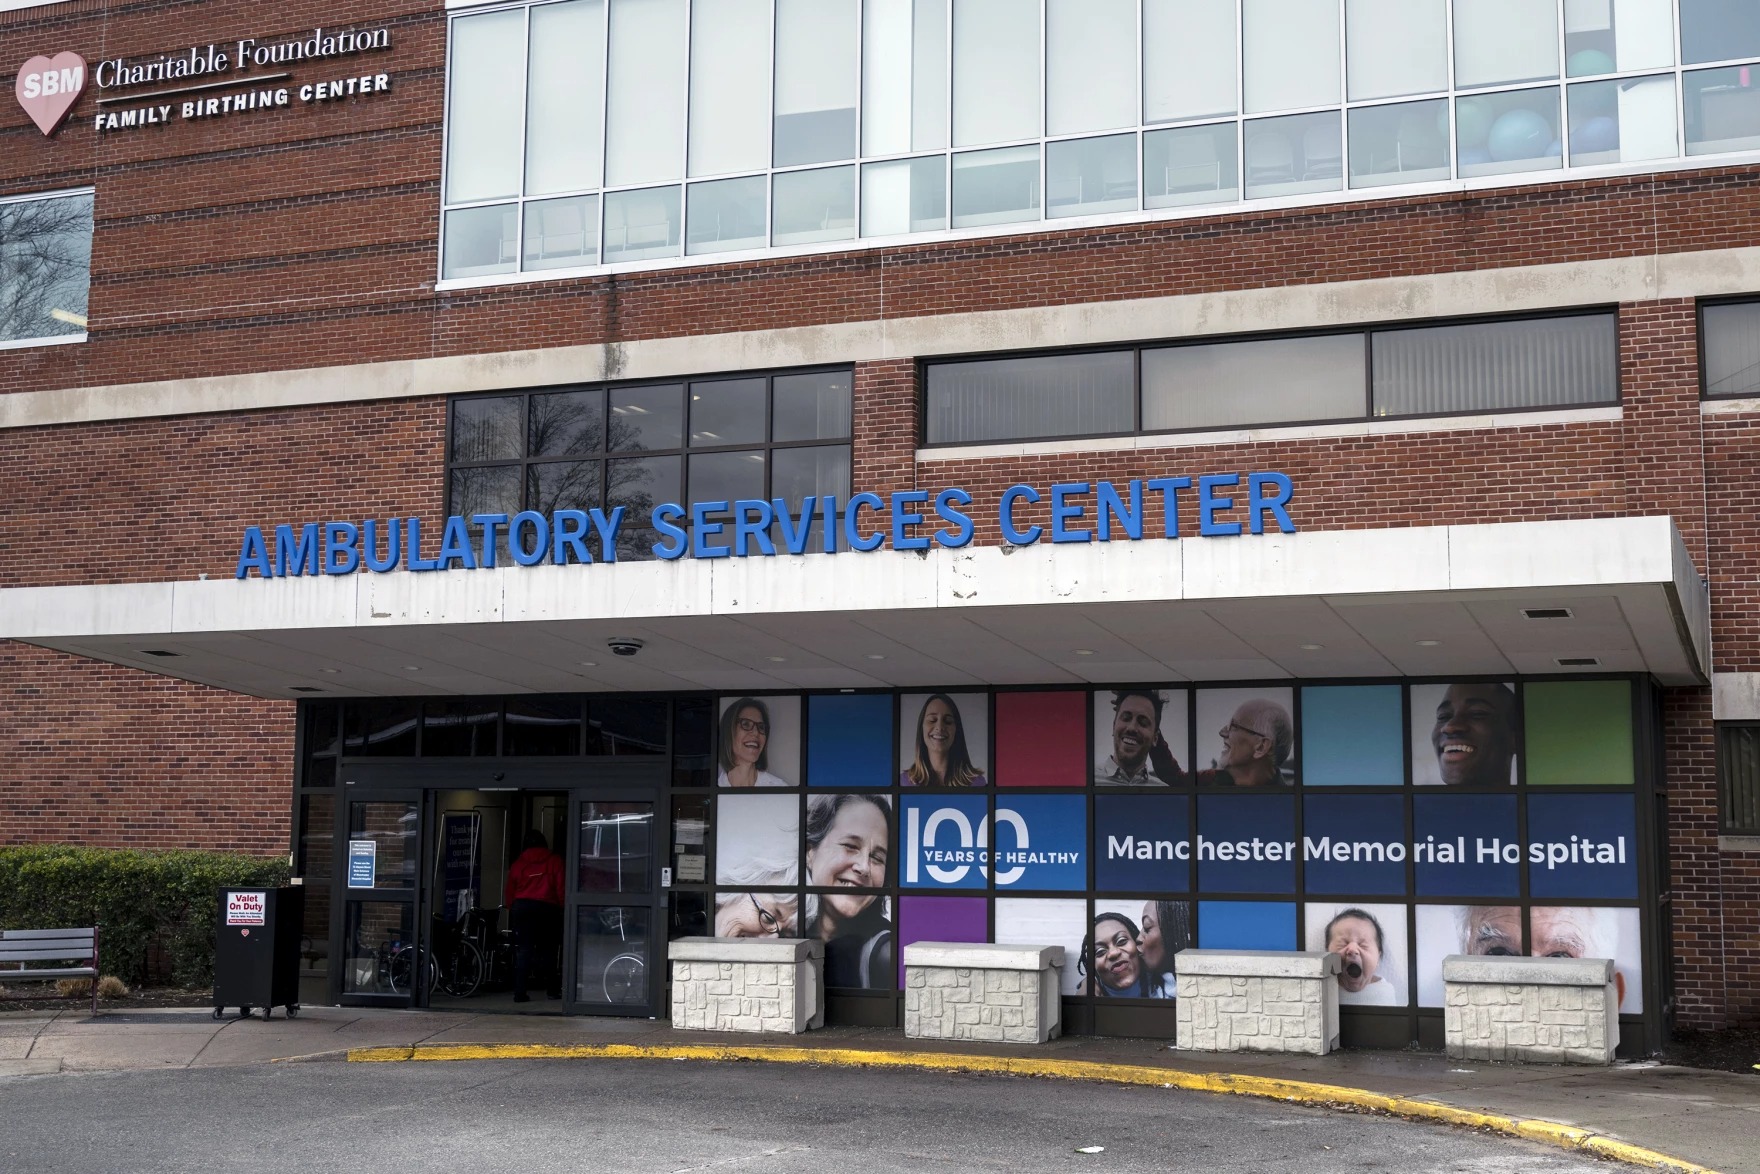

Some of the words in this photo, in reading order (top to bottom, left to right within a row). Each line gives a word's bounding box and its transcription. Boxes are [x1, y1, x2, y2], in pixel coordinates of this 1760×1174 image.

[96, 46, 228, 89] Charitable
[236, 28, 390, 69] Foundation
[23, 66, 83, 99] SBM
[94, 104, 172, 131] FAMILY
[181, 88, 289, 119] BIRTHING
[299, 73, 390, 102] CENTER
[235, 506, 626, 579] AMBULATORY
[651, 487, 976, 561] SERVICES
[998, 471, 1297, 547] CENTER
[924, 850, 975, 863] YEARS
[1005, 851, 1079, 866] HEALTHY
[1107, 834, 1297, 862] Manchester
[1302, 835, 1465, 864] Memorial
[1475, 834, 1627, 870] Hospital
[243, 902, 262, 912] Duty
